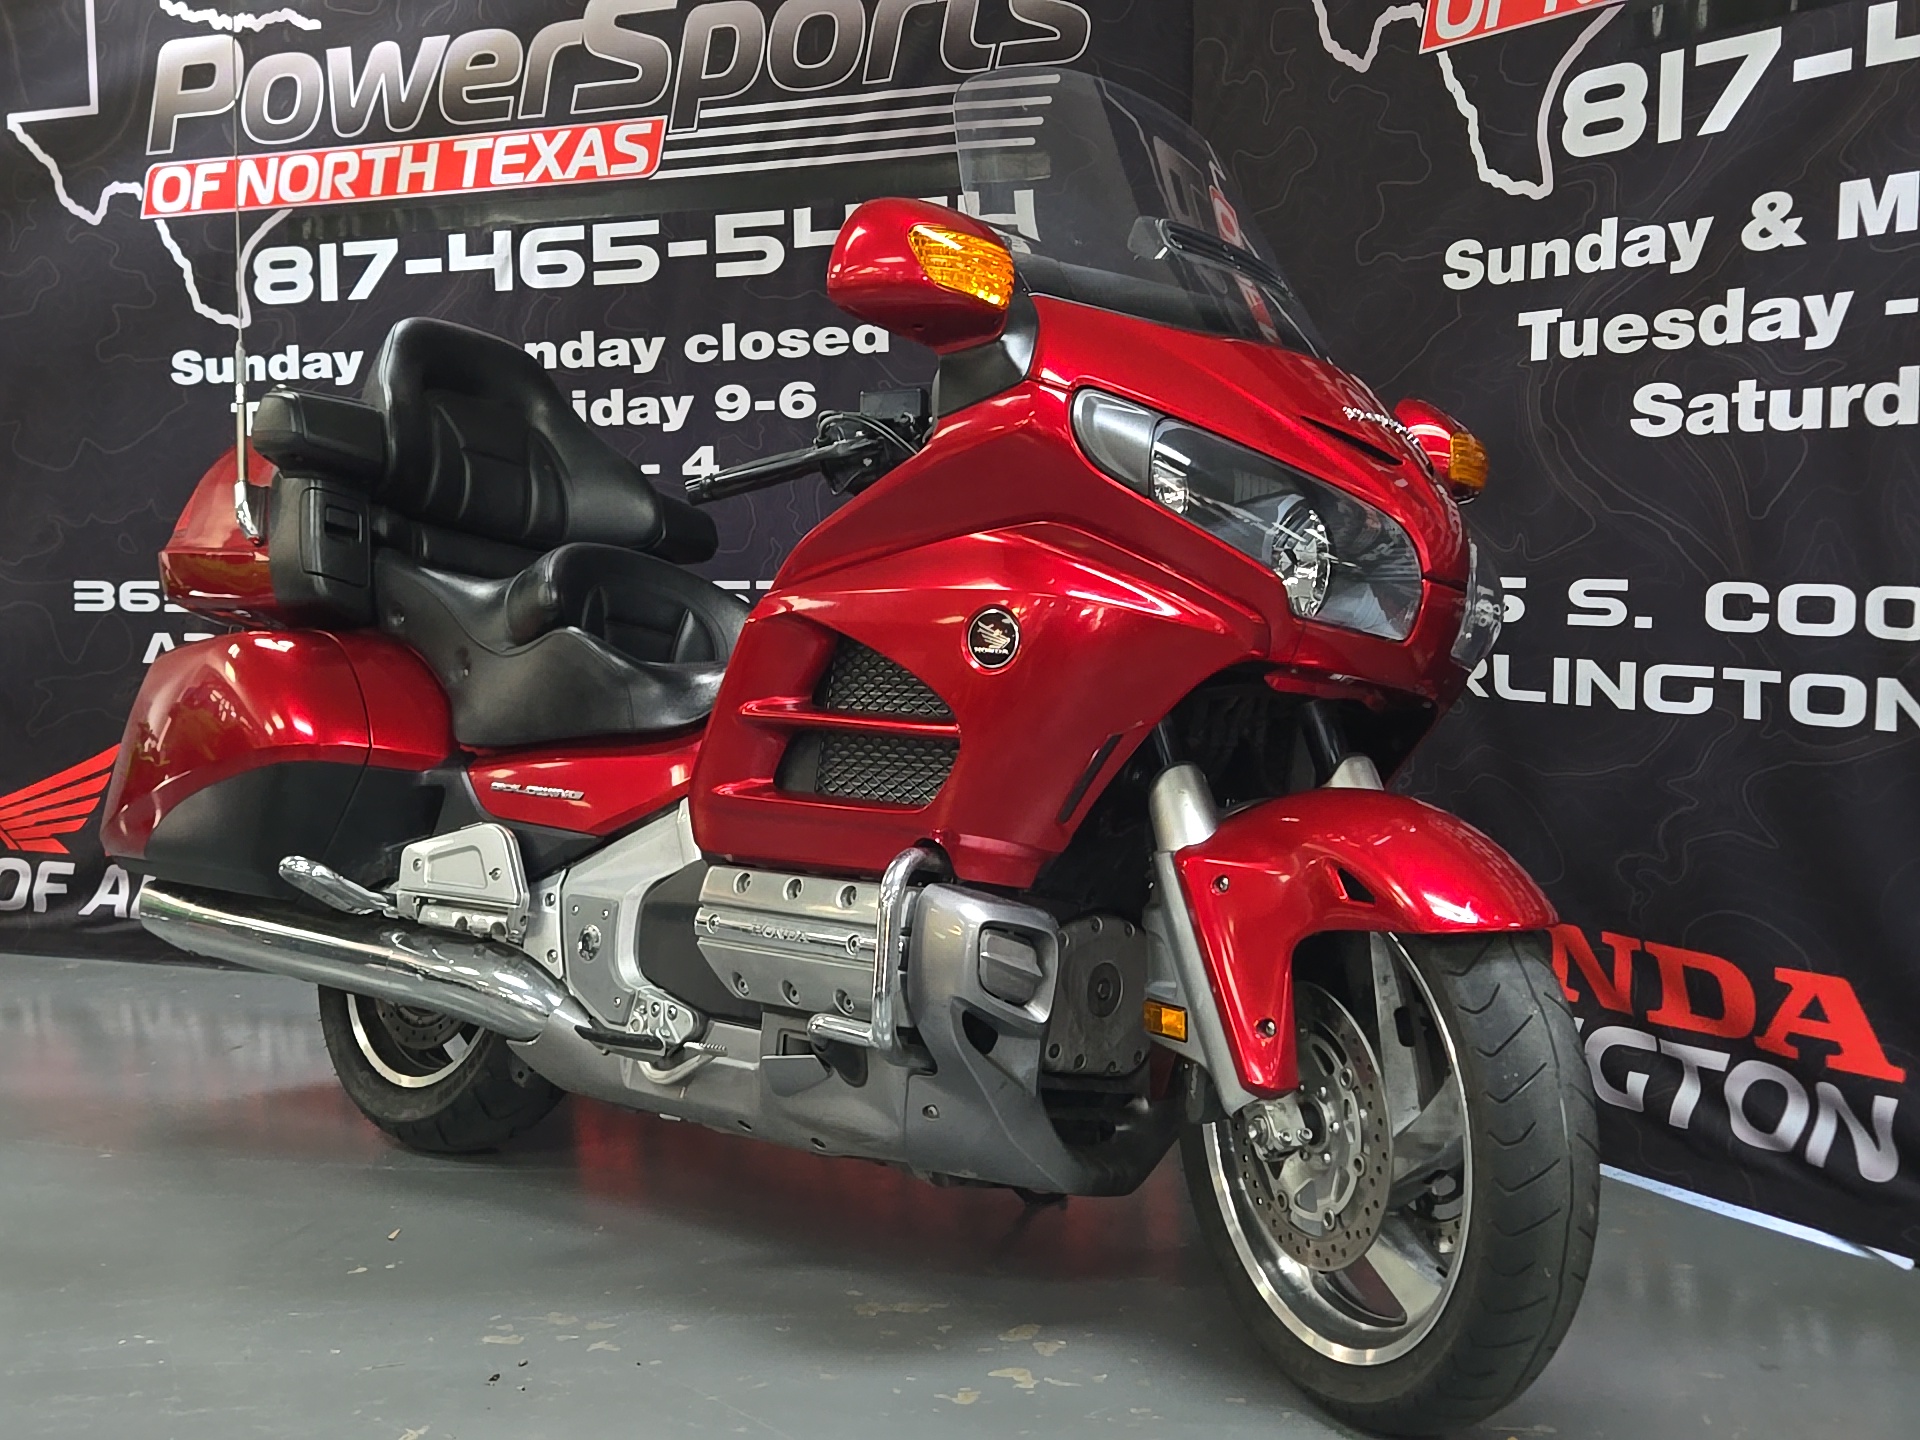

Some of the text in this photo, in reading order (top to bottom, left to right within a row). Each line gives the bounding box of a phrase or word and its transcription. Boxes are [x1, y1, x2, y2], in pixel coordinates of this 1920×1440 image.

[146, 0, 1090, 155] PowerSports
[150, 122, 653, 213] OF NORTH TEXAS
[252, 190, 1042, 305] 817-465-544
[1443, 216, 1714, 290] Sunday
[1741, 191, 1806, 251] &
[170, 322, 890, 386] Sunday nday closed
[1518, 288, 1855, 361] Tuesday
[571, 381, 817, 432] iday 9-6
[1630, 366, 1920, 437] Saturd
[1567, 579, 1652, 628] S.
[1544, 923, 1907, 1083] NDA
[1574, 1016, 1900, 1183] GTON
